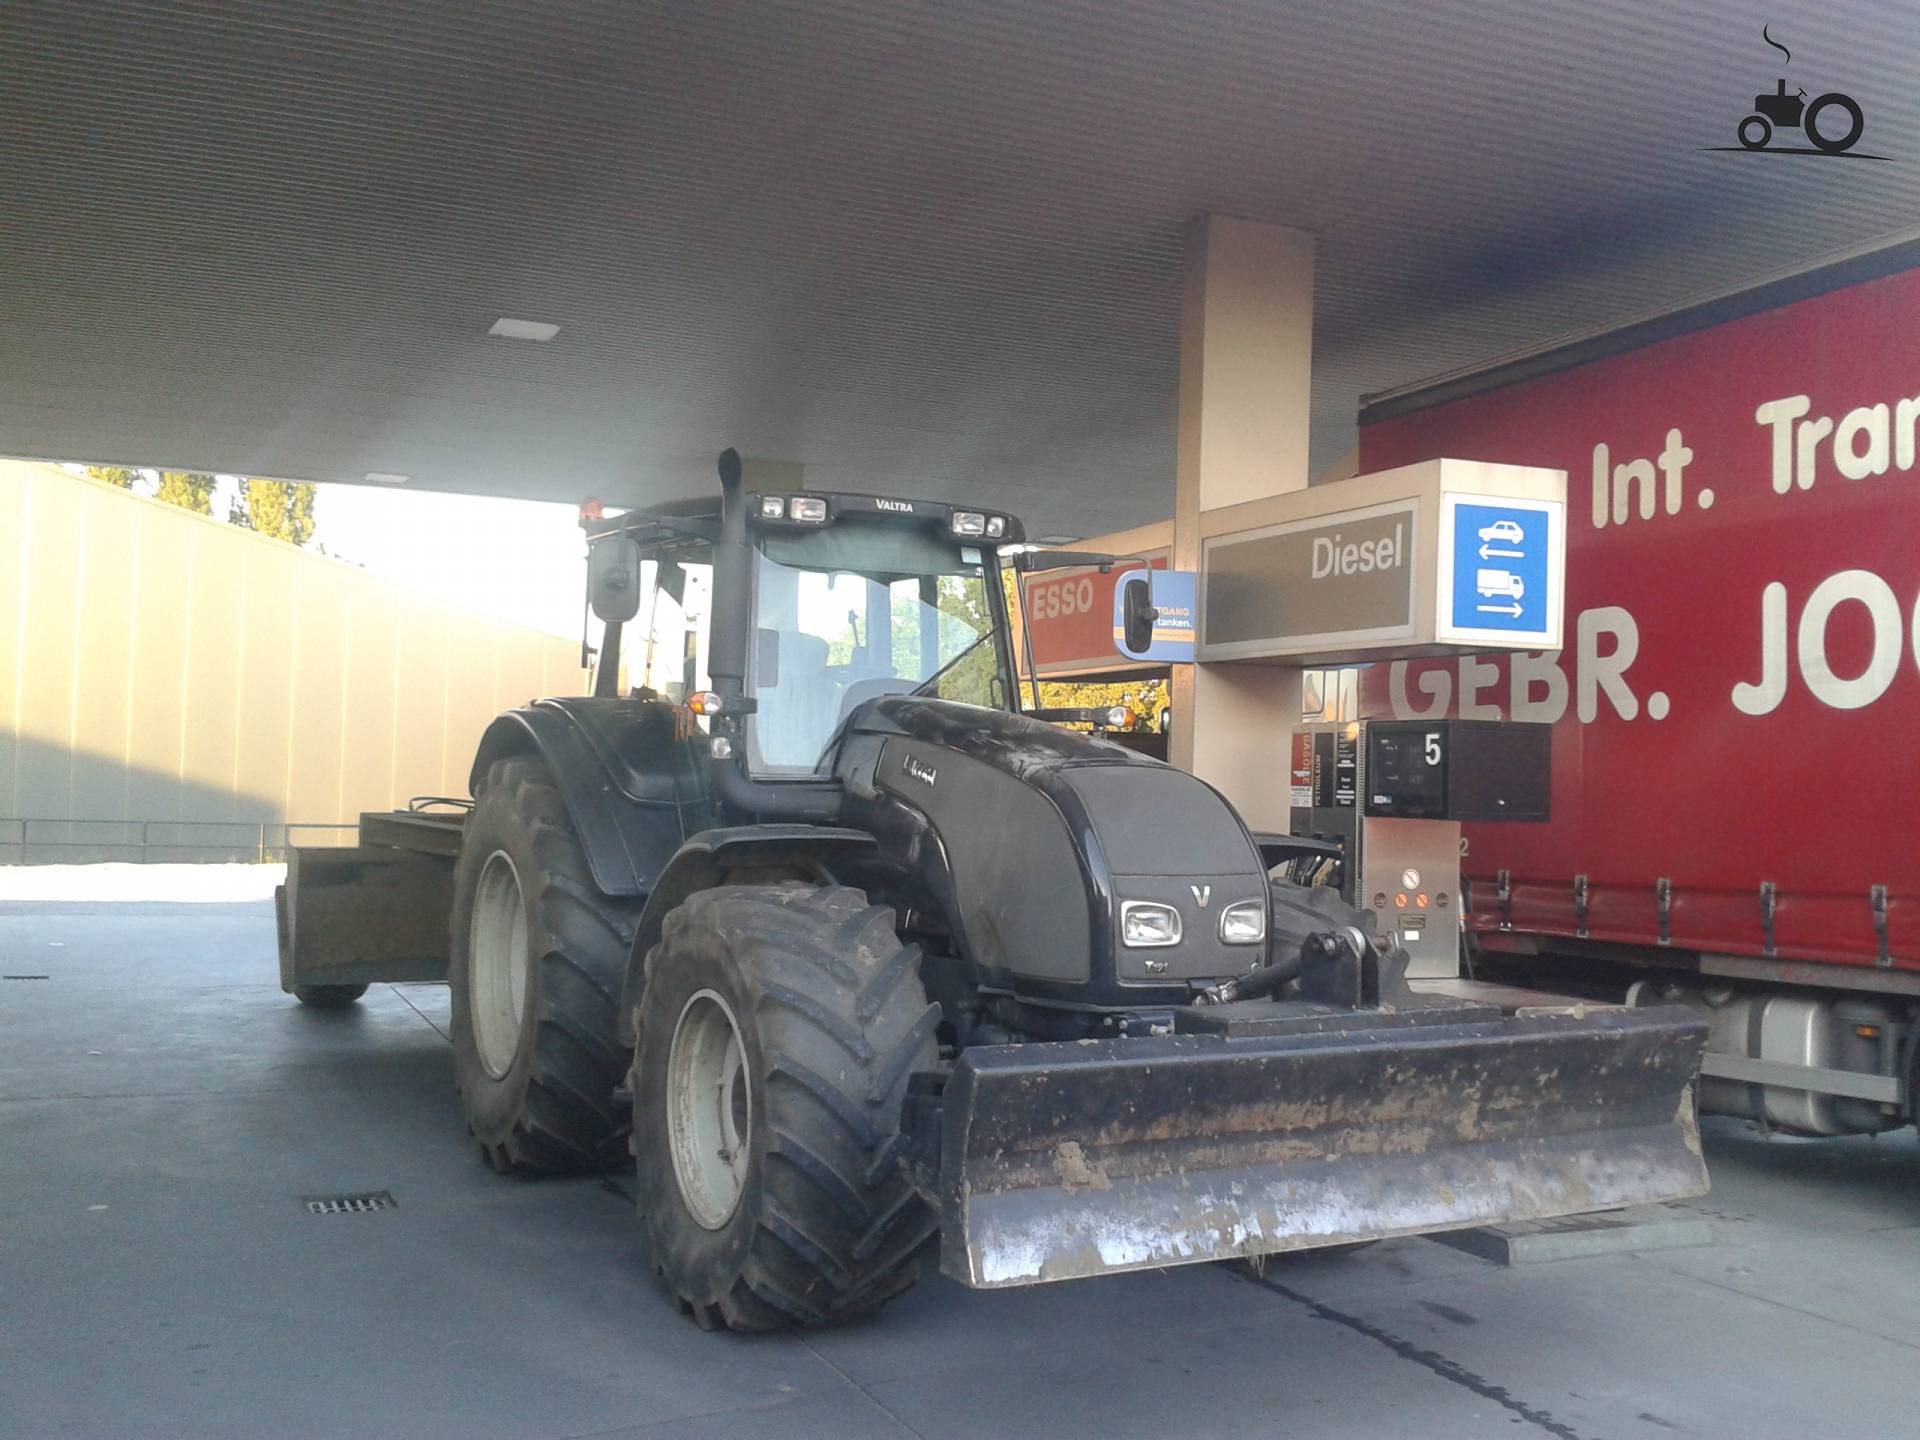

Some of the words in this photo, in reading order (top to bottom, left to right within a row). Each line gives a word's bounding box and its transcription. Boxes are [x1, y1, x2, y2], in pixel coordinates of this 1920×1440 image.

[1592, 428, 1714, 528] Int.
[876, 498, 913, 512] VALTRA
[1312, 523, 1402, 579] Diesel
[1033, 578, 1093, 620] ESSO
[1389, 606, 1670, 724] GEBR.
[1731, 569, 1920, 715] JO
[1425, 733, 1441, 766] 5
